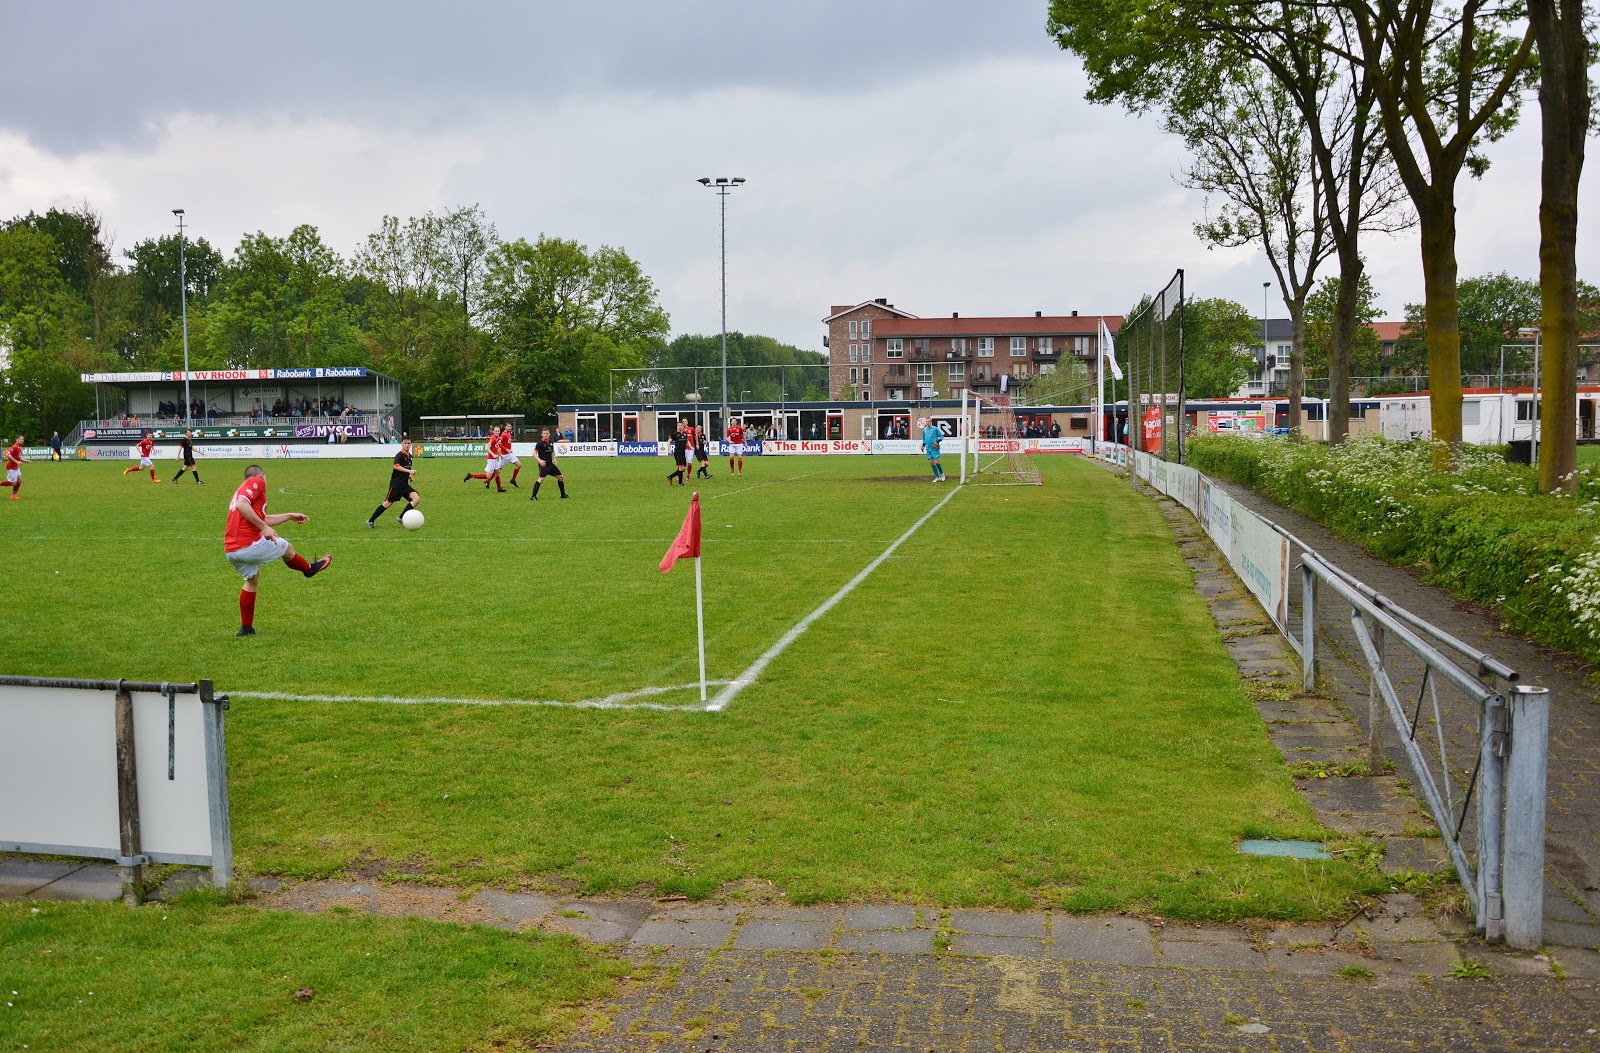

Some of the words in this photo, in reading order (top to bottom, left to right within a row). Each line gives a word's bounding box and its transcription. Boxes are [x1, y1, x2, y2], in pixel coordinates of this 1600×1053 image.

[195, 372, 208, 380] VV
[211, 371, 247, 380] RHOON
[276, 369, 312, 378] Rabobank
[325, 368, 361, 377] Rabobank
[316, 425, 367, 436] MYSC.nl
[467, 443, 473, 451] &
[619, 445, 658, 453] Rabobank
[721, 444, 760, 452] Rabank
[775, 441, 797, 451] The
[801, 441, 828, 453] King
[833, 441, 859, 451] Side
[978, 443, 1008, 451] ESPECT
